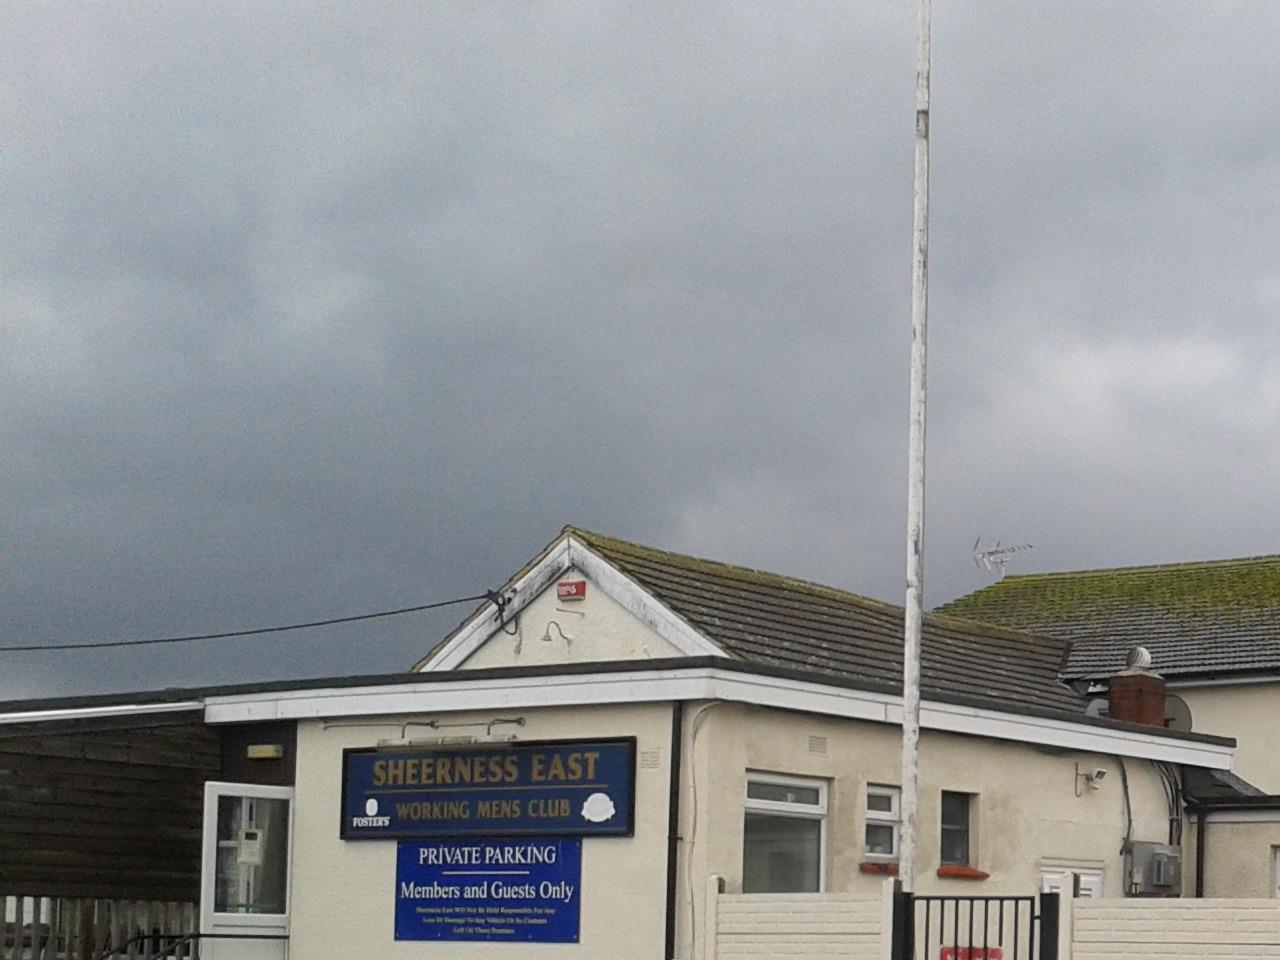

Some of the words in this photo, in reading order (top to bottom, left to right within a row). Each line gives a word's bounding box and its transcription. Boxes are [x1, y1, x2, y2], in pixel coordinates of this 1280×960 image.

[373, 755, 519, 786] SHEERNESS
[531, 752, 600, 781] EAST
[396, 801, 470, 819] WORKING
[477, 799, 521, 818] MENS
[527, 798, 572, 817] CLUB
[419, 846, 482, 865] PRIVATE
[485, 845, 557, 865] PARKING
[400, 881, 461, 899] Members
[463, 880, 488, 899] and
[491, 881, 537, 899] Guests
[539, 880, 574, 903] Only
